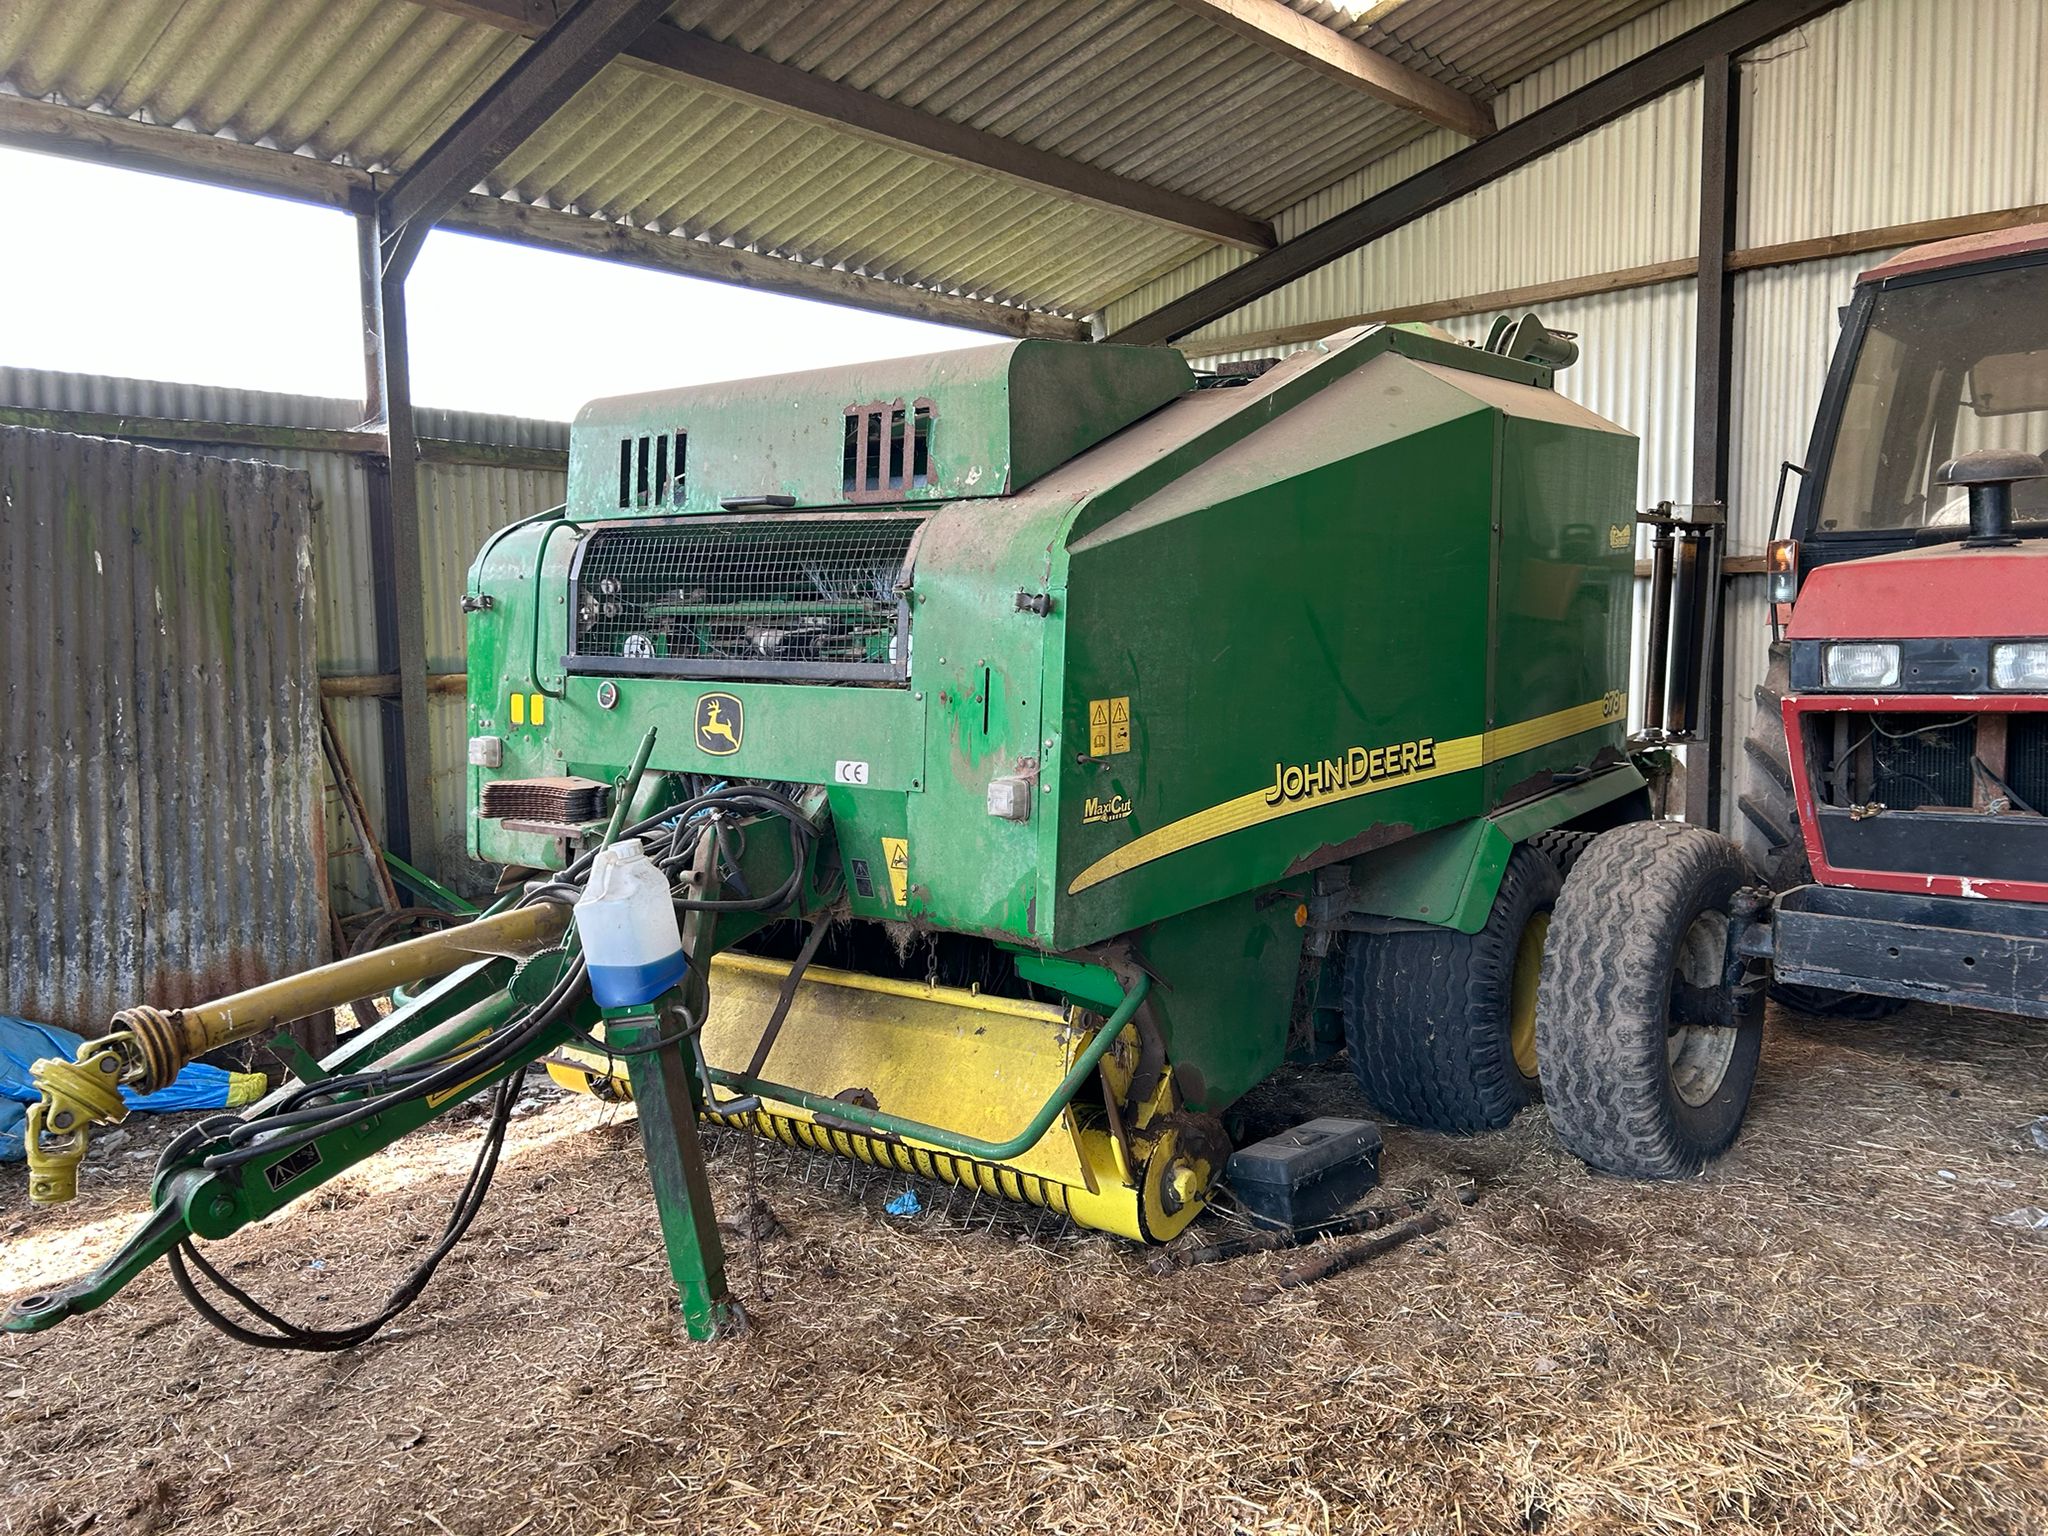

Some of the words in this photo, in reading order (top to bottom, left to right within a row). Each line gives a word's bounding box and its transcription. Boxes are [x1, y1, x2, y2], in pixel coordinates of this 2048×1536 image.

[1603, 689, 1621, 716] 678
[842, 763, 862, 782] CE
[1265, 757, 1345, 803] JOHN
[1348, 738, 1435, 784] DEERE
[1084, 795, 1132, 818] MaxiCut
